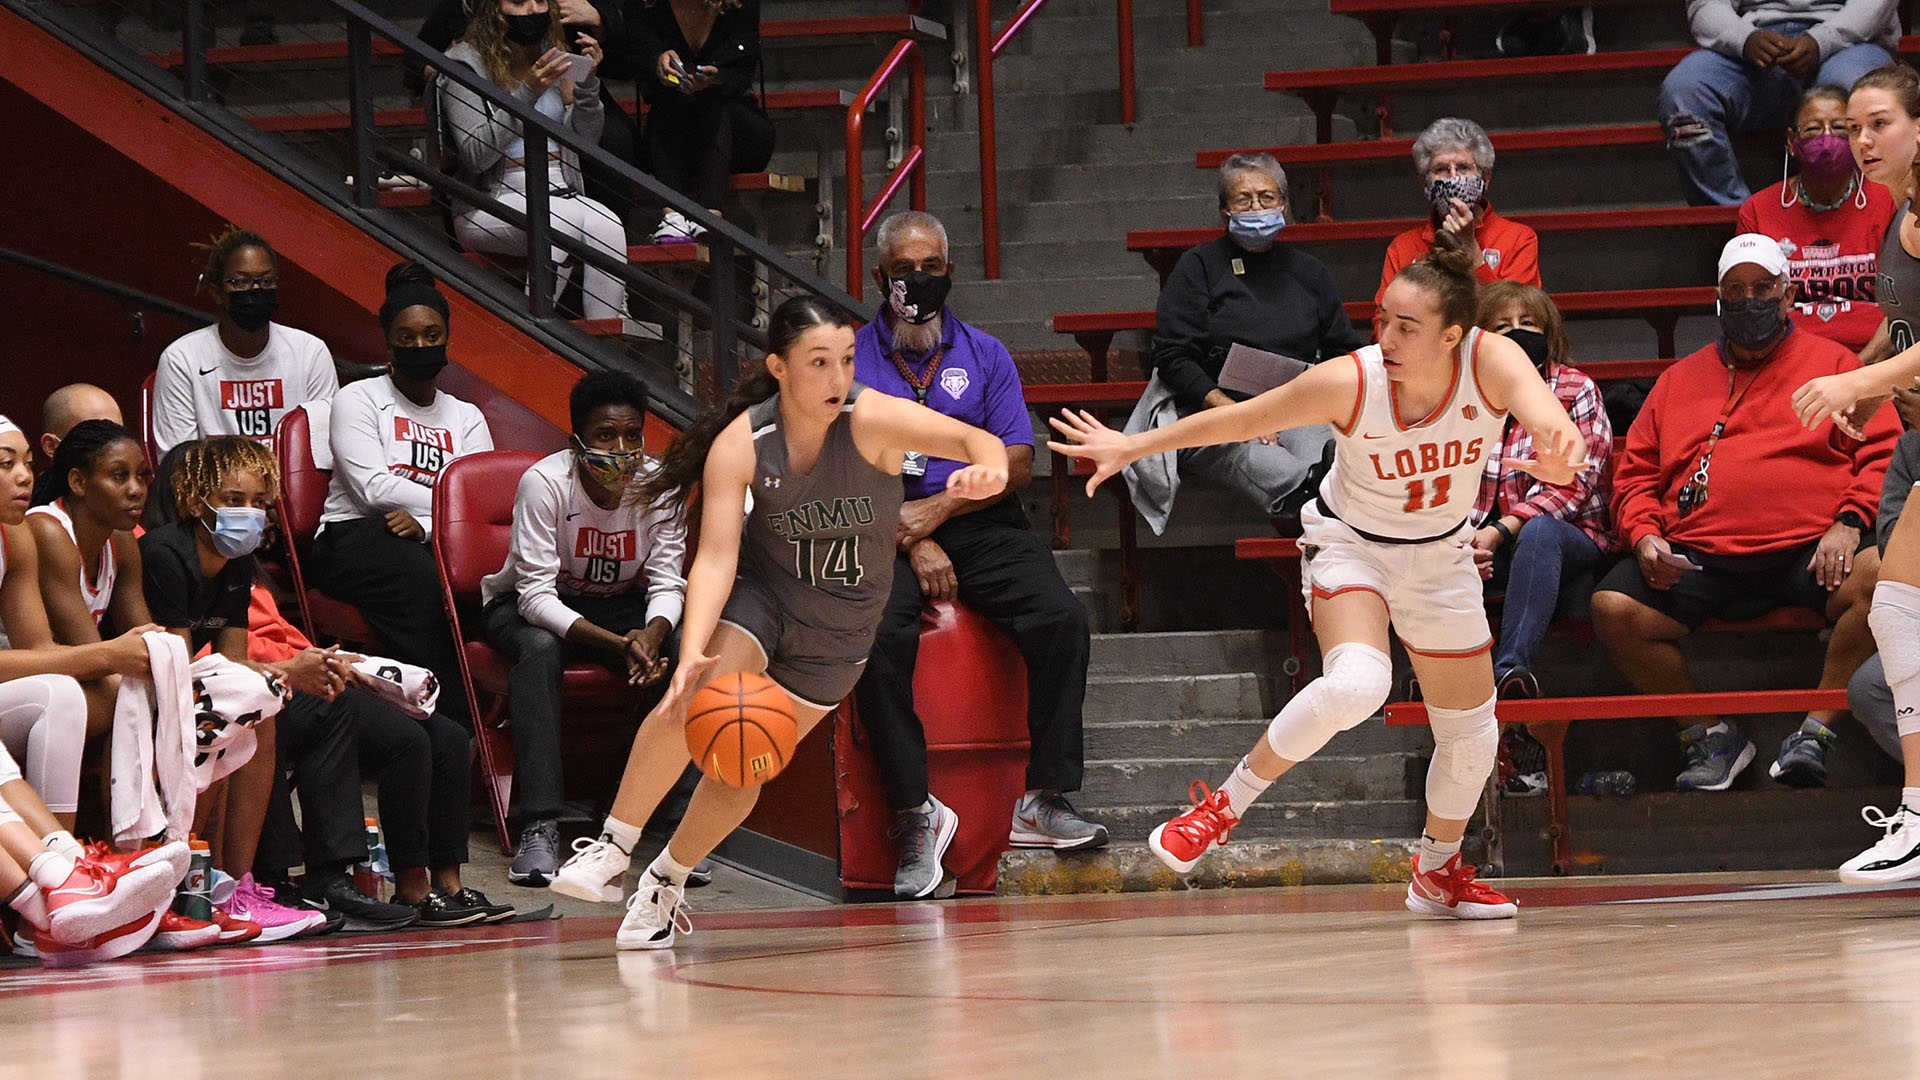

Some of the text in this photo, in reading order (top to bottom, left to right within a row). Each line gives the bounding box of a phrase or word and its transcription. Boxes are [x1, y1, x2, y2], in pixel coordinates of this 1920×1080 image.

[227, 381, 275, 408] JUST
[240, 410, 267, 436] US
[402, 420, 447, 449] JUST
[415, 443, 440, 472] US
[1368, 437, 1483, 480] LOBOS
[1402, 474, 1451, 513] 11
[767, 496, 876, 538] ENMU
[583, 529, 627, 560] JUST
[590, 558, 616, 583] US
[786, 535, 864, 586] 14
